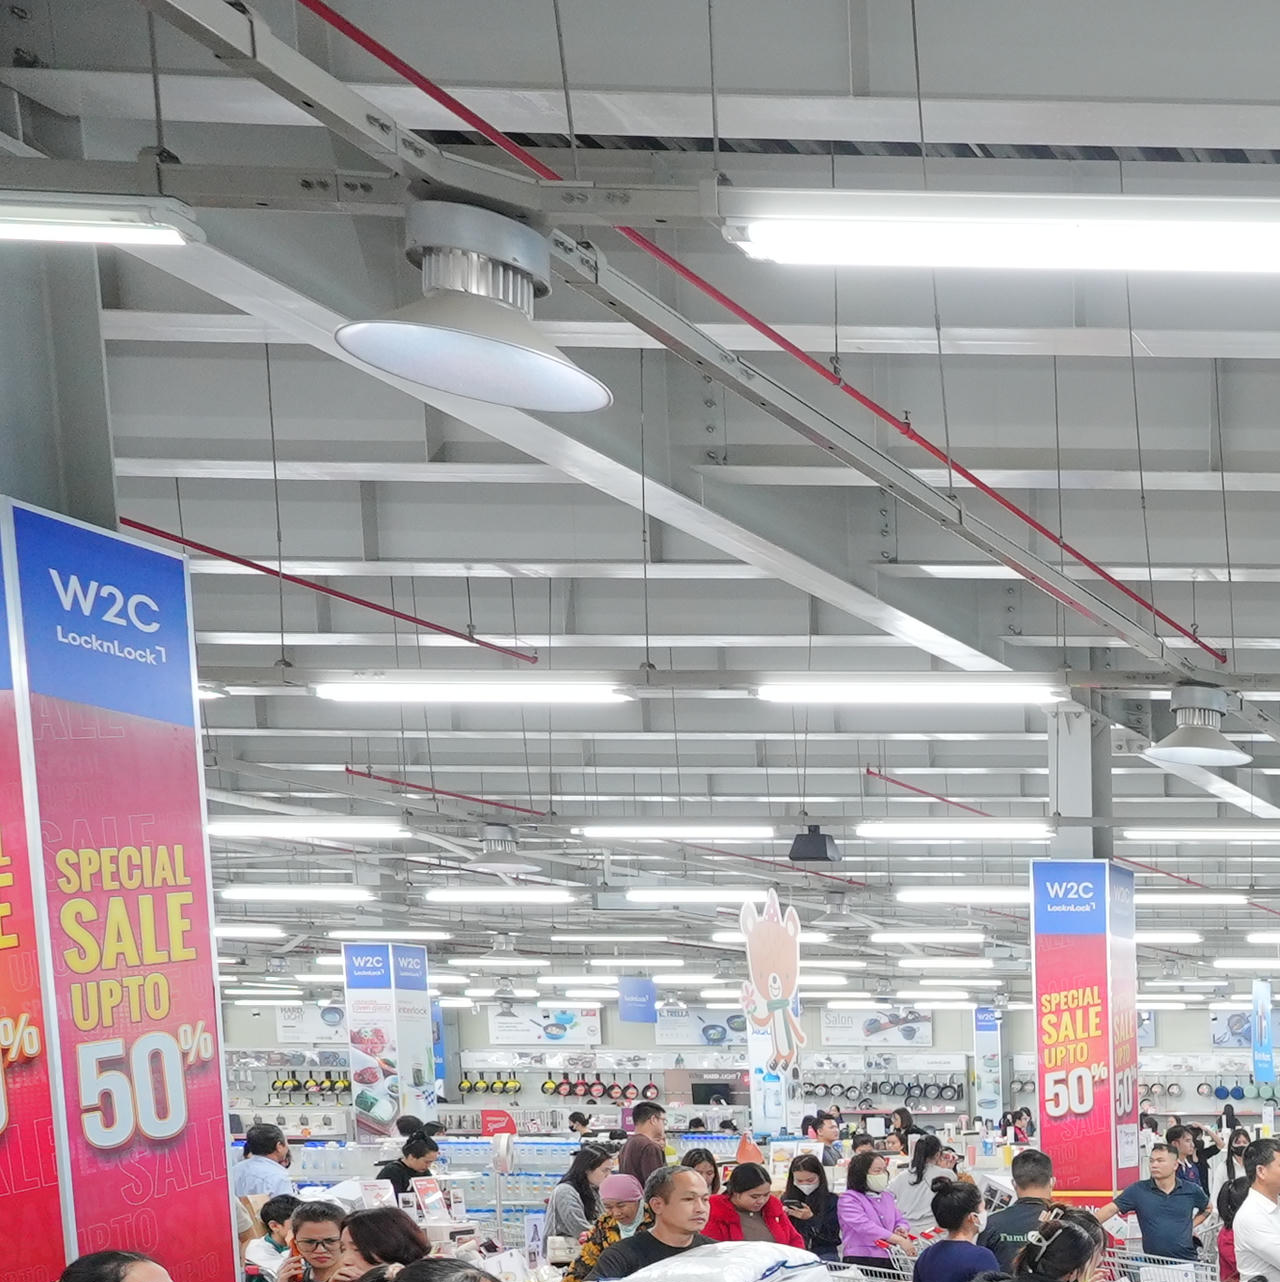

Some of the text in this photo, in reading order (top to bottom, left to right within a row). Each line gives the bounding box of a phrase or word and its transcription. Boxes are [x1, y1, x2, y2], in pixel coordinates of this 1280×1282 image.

[49, 567, 161, 633] W2C
[56, 624, 158, 666] LocknLock
[55, 844, 192, 894] SPECIAL
[1046, 881, 1095, 899] W2C
[59, 891, 197, 974] SALE
[352, 956, 383, 968] W2C
[398, 956, 421, 969] W2C
[824, 1012, 854, 1025] Salon
[1041, 985, 1102, 1013] SPECIAL
[1041, 1006, 1102, 1045] SALE
[1113, 1012, 1134, 1044] SALE
[76, 1020, 214, 1151] 50%
[1044, 1061, 1108, 1118] 50%
